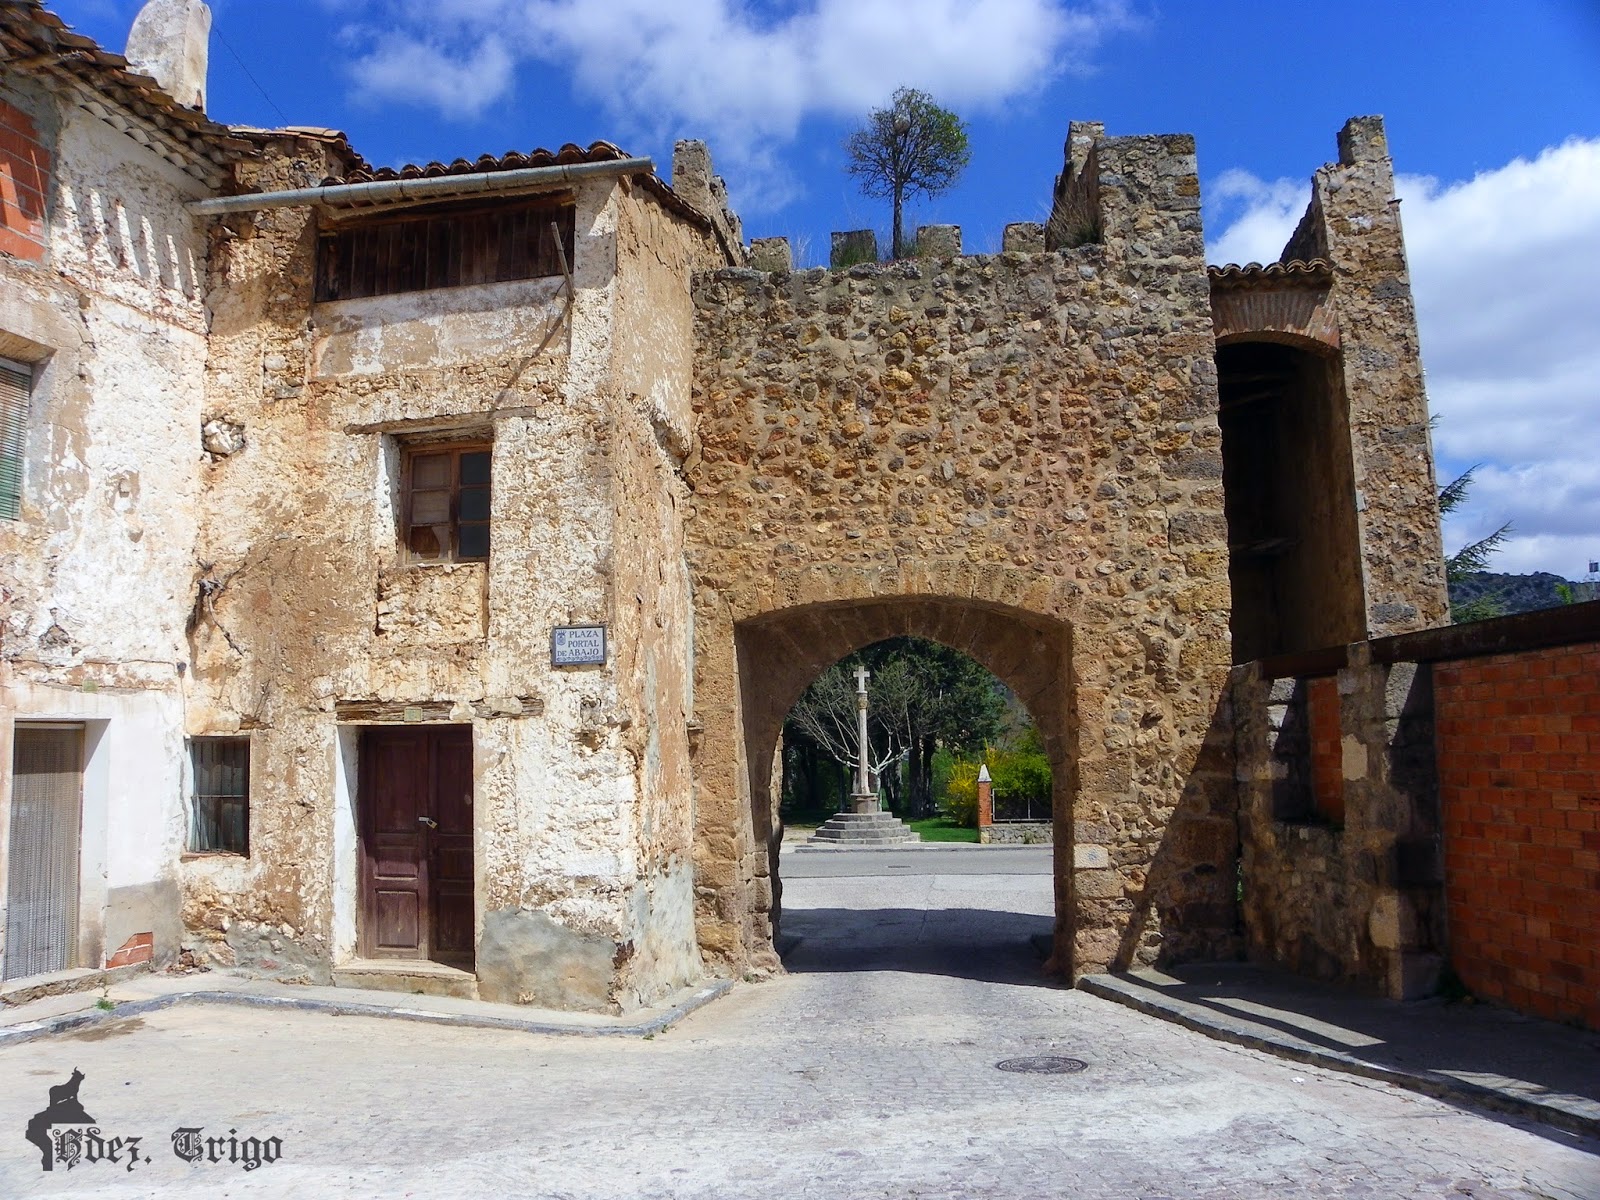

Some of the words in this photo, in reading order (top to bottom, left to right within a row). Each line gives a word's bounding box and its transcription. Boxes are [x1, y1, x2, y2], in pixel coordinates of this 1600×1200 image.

[569, 630, 599, 638] PLAZA
[568, 640, 599, 648] PORTAL
[568, 648, 599, 657] ABAJO
